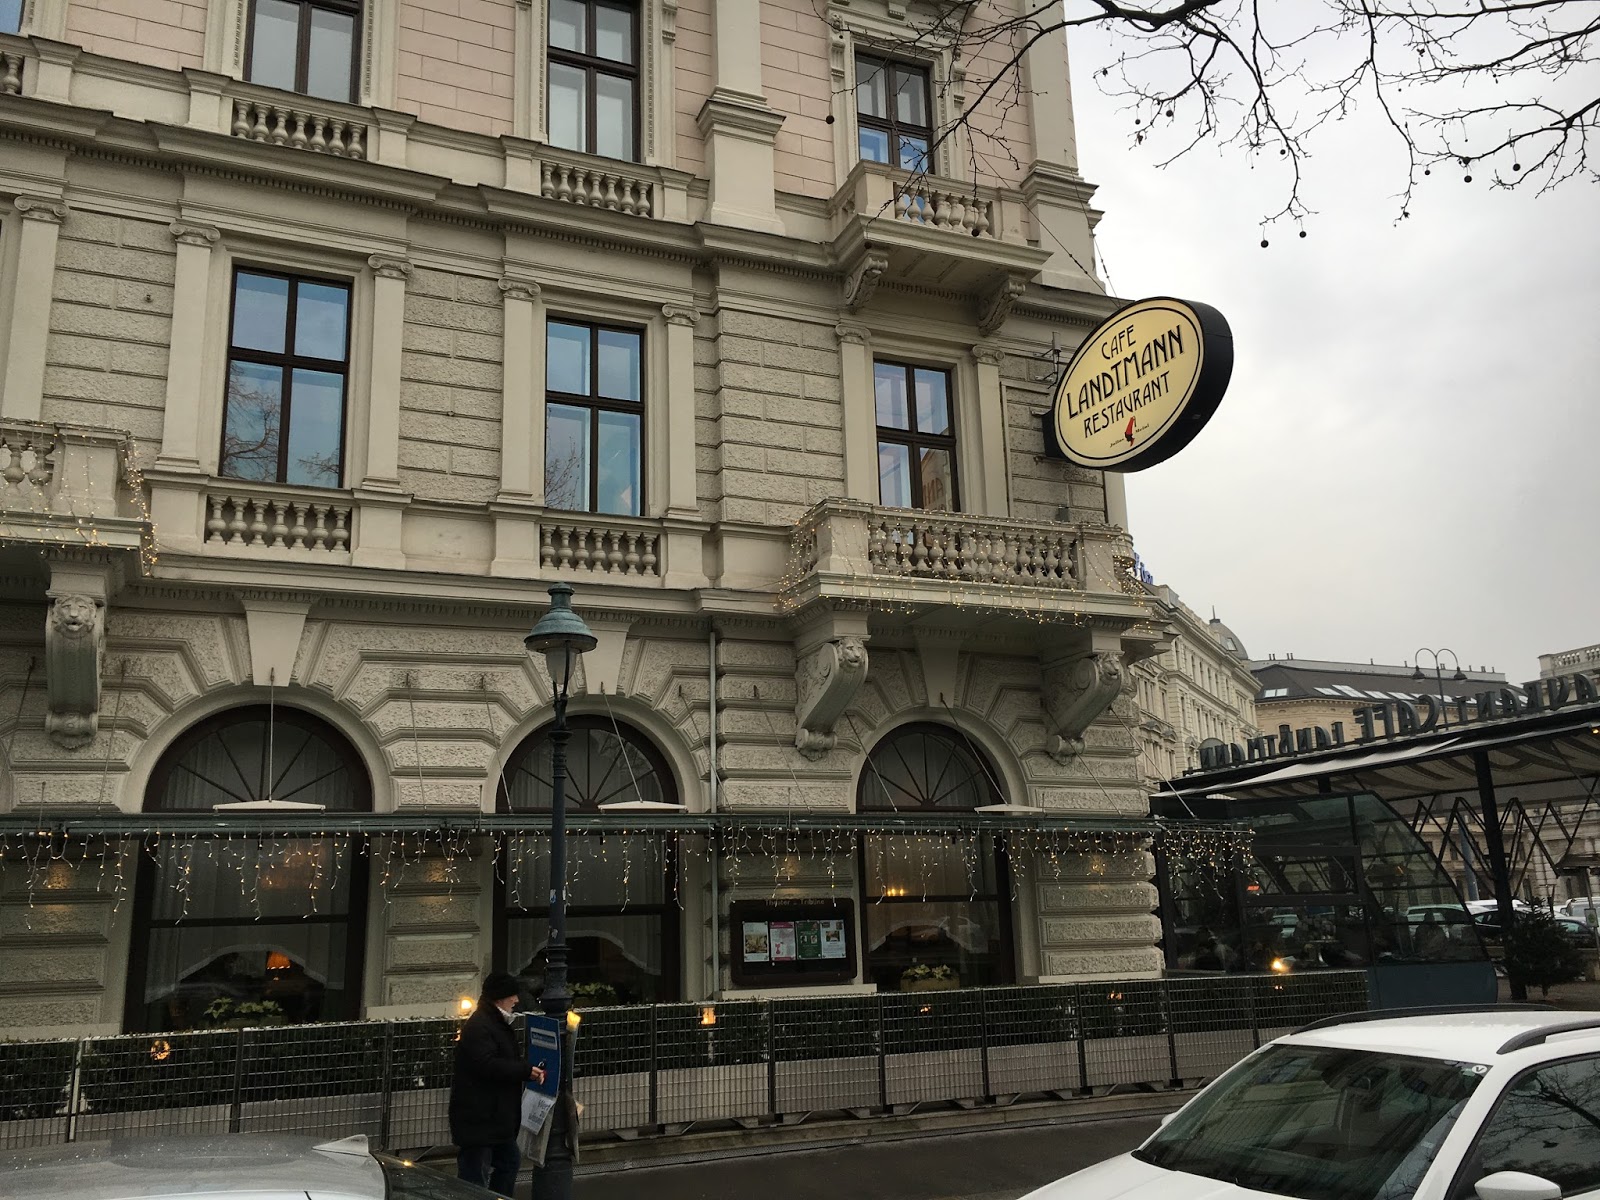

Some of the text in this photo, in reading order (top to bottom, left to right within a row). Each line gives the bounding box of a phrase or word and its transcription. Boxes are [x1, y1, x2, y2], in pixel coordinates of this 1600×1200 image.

[1067, 324, 1185, 419] LANDTMANN
[1101, 324, 1137, 360] CAFE
[1084, 371, 1170, 438] RESTAURANT
